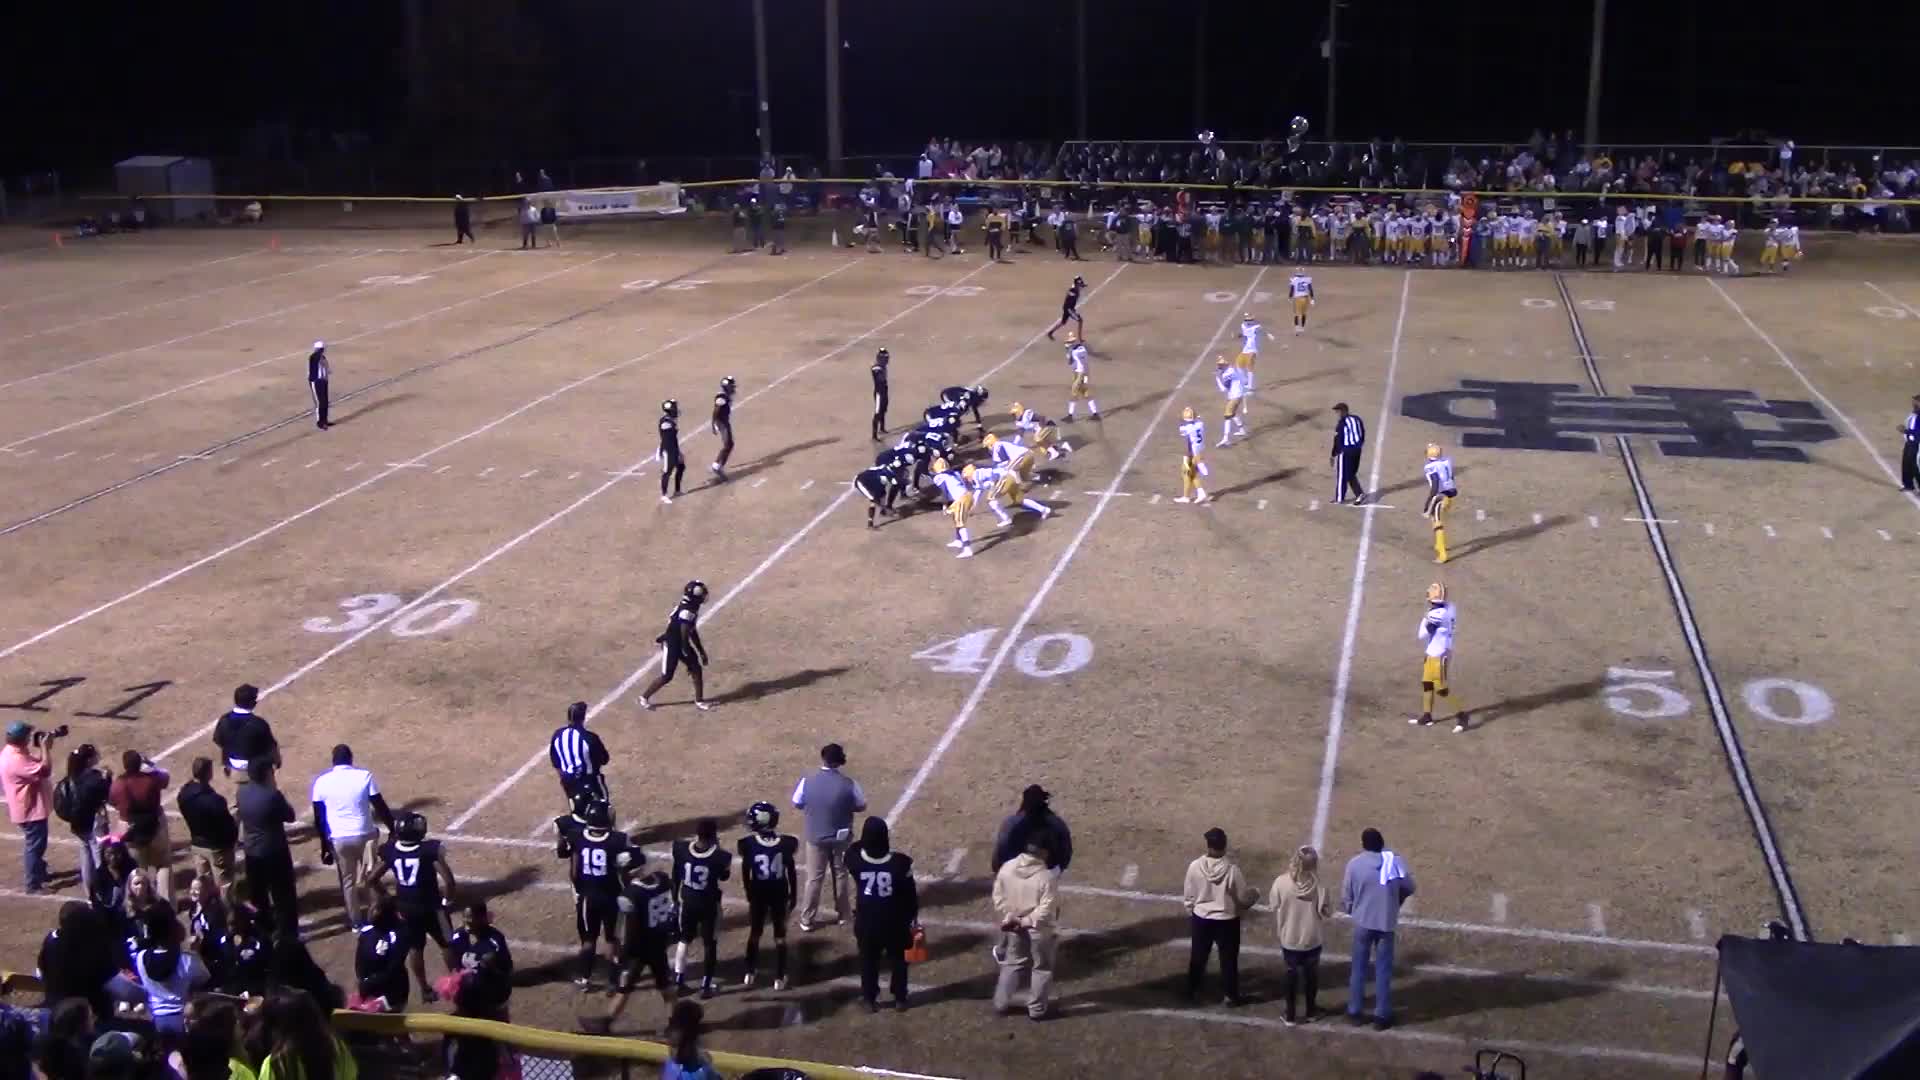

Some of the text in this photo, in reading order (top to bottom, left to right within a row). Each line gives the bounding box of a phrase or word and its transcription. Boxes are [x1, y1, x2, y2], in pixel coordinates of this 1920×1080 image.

[302, 593, 481, 636] 30
[910, 627, 1095, 678] 40
[1605, 666, 1835, 725] 50
[393, 858, 420, 886] 17
[581, 847, 607, 876] 19
[683, 861, 710, 891] 13
[754, 852, 784, 881] 34
[859, 871, 893, 898] 78
